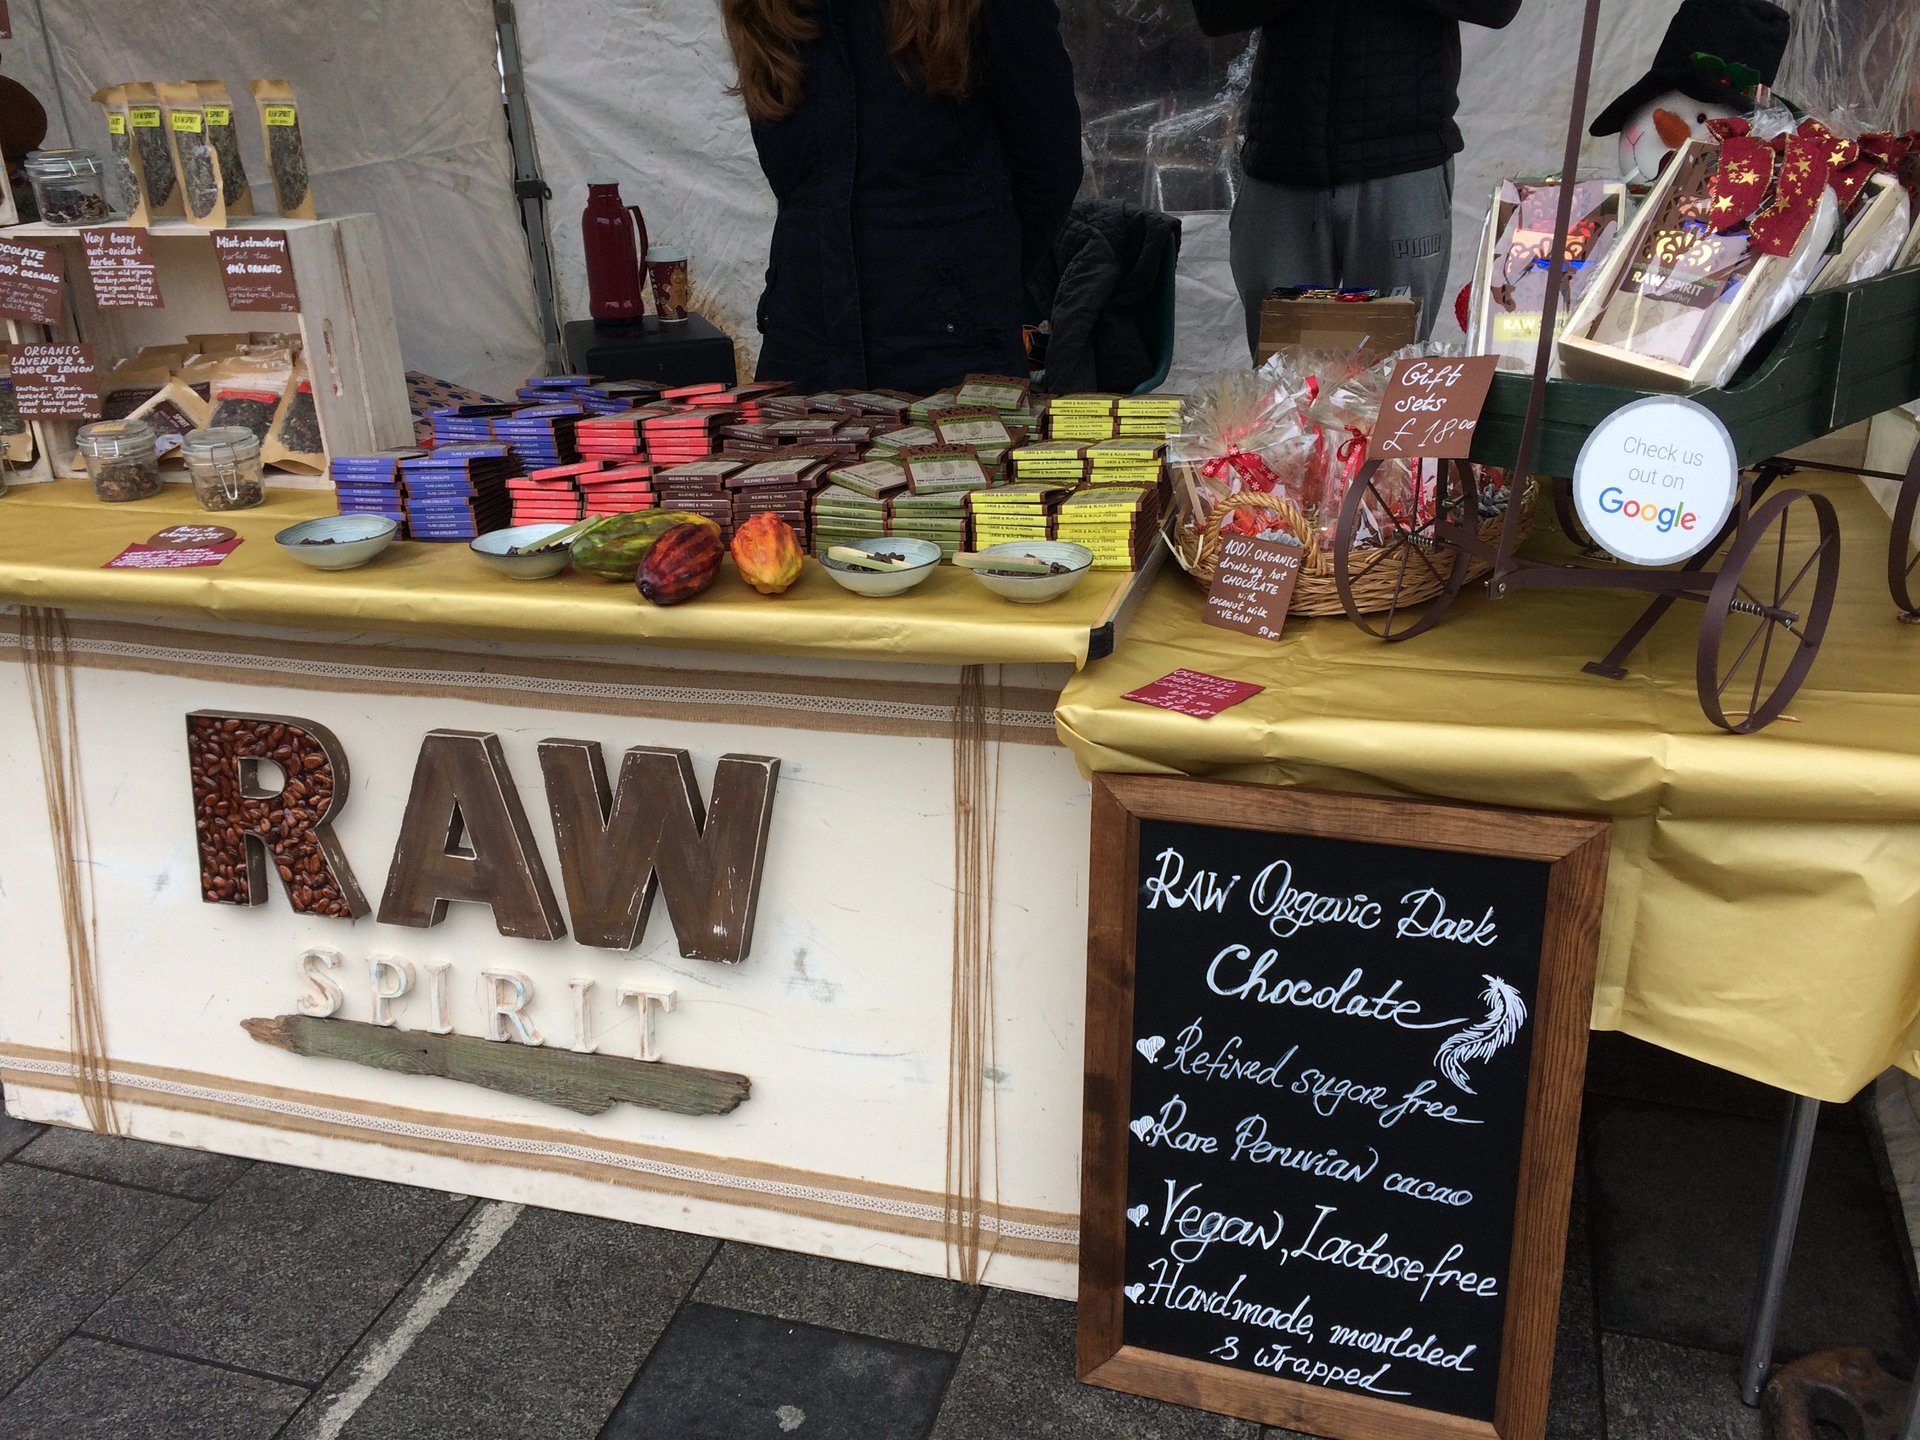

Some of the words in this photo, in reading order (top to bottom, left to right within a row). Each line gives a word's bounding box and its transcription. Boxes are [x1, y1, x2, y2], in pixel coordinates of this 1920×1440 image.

[1392, 233, 1441, 258] PUMA
[1632, 270, 1666, 289] RAW
[1665, 276, 1705, 298] SPIRIT
[1503, 318, 1536, 335] RAW
[11, 356, 74, 366] LAVENDER
[24, 345, 81, 357] ORGANIC
[42, 374, 66, 383] TEA
[1401, 362, 1465, 392] Gift
[1394, 393, 1447, 412] sets
[1623, 436, 1678, 462] Check
[1682, 451, 1705, 467] us
[1628, 467, 1659, 485] out
[1662, 473, 1685, 490] on
[1598, 486, 1697, 533] Google
[1225, 539, 1255, 558] 100%
[1254, 549, 1299, 569] ORGANIC
[1222, 574, 1280, 596] CHOCOLATE
[1268, 567, 1288, 581] hot
[1237, 592, 1257, 603] with
[1173, 669, 1237, 688] ORGANIC
[186, 708, 781, 965] RAW
[1396, 887, 1499, 948] Dark
[1206, 943, 1471, 1030] Chocolate
[296, 947, 678, 1063] SPIRIT
[1164, 1016, 1298, 1089] Refined
[1291, 1066, 1393, 1117] sugar
[1378, 1079, 1486, 1128] free
[1149, 1094, 1218, 1152] Rare
[1230, 1114, 1379, 1183] Peruvian
[1383, 1170, 1474, 1207] cacao
[1330, 1322, 1477, 1372] moulded
[1253, 1342, 1413, 1396] wrapped
